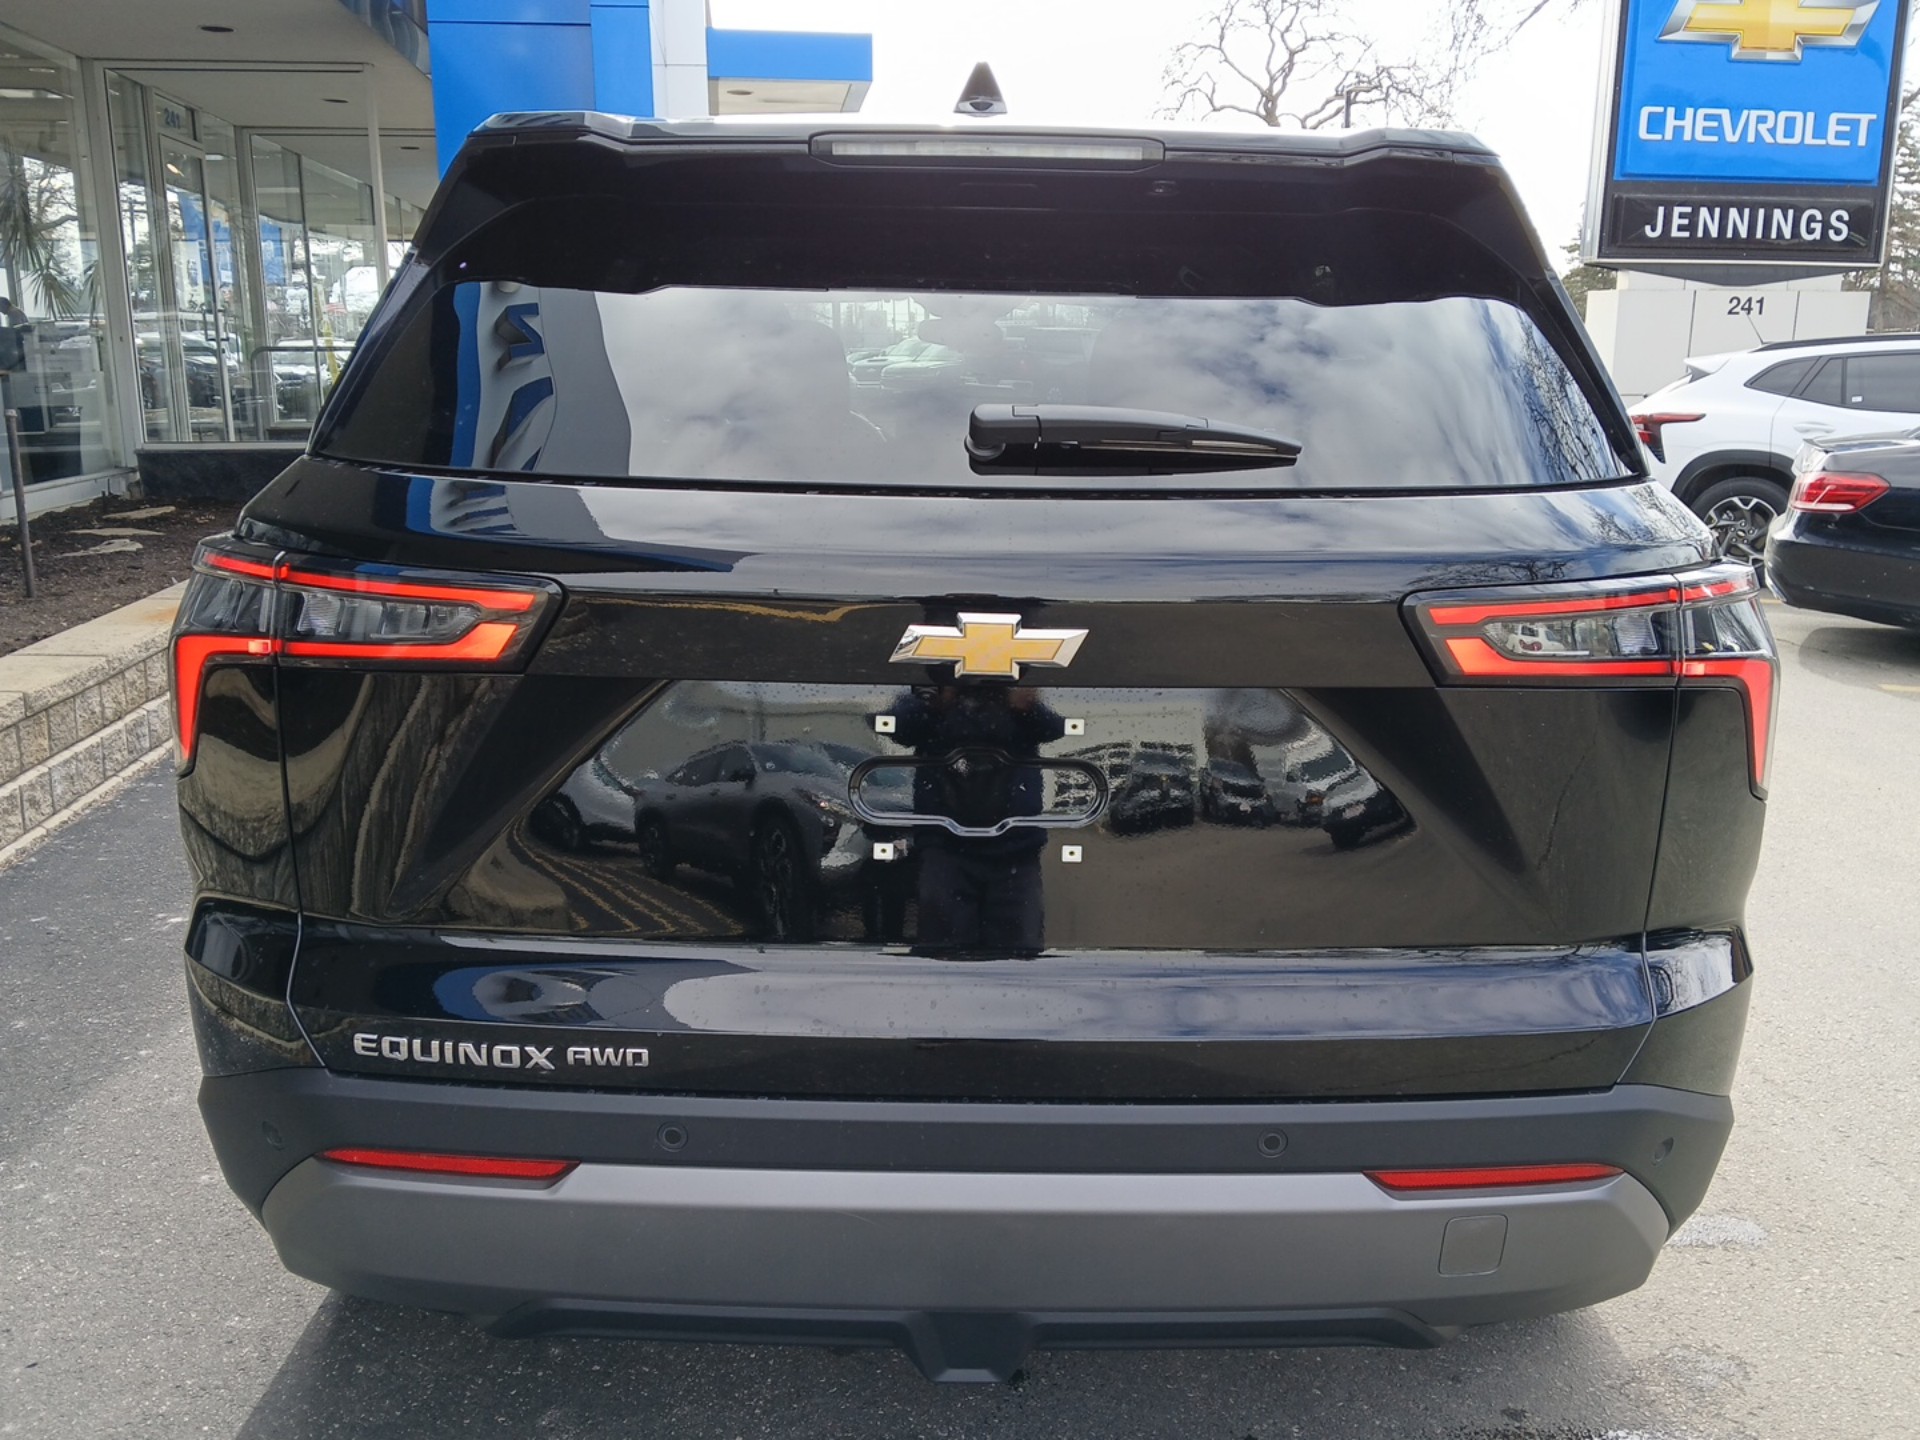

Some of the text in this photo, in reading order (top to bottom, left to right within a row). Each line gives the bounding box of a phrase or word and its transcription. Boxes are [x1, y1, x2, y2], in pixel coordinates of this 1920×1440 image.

[1638, 106, 1877, 147] CHEVROLET
[1644, 206, 1850, 242] JENNINGS
[1727, 296, 1765, 315] 241
[353, 1033, 649, 1070] EQUINOX AWD
